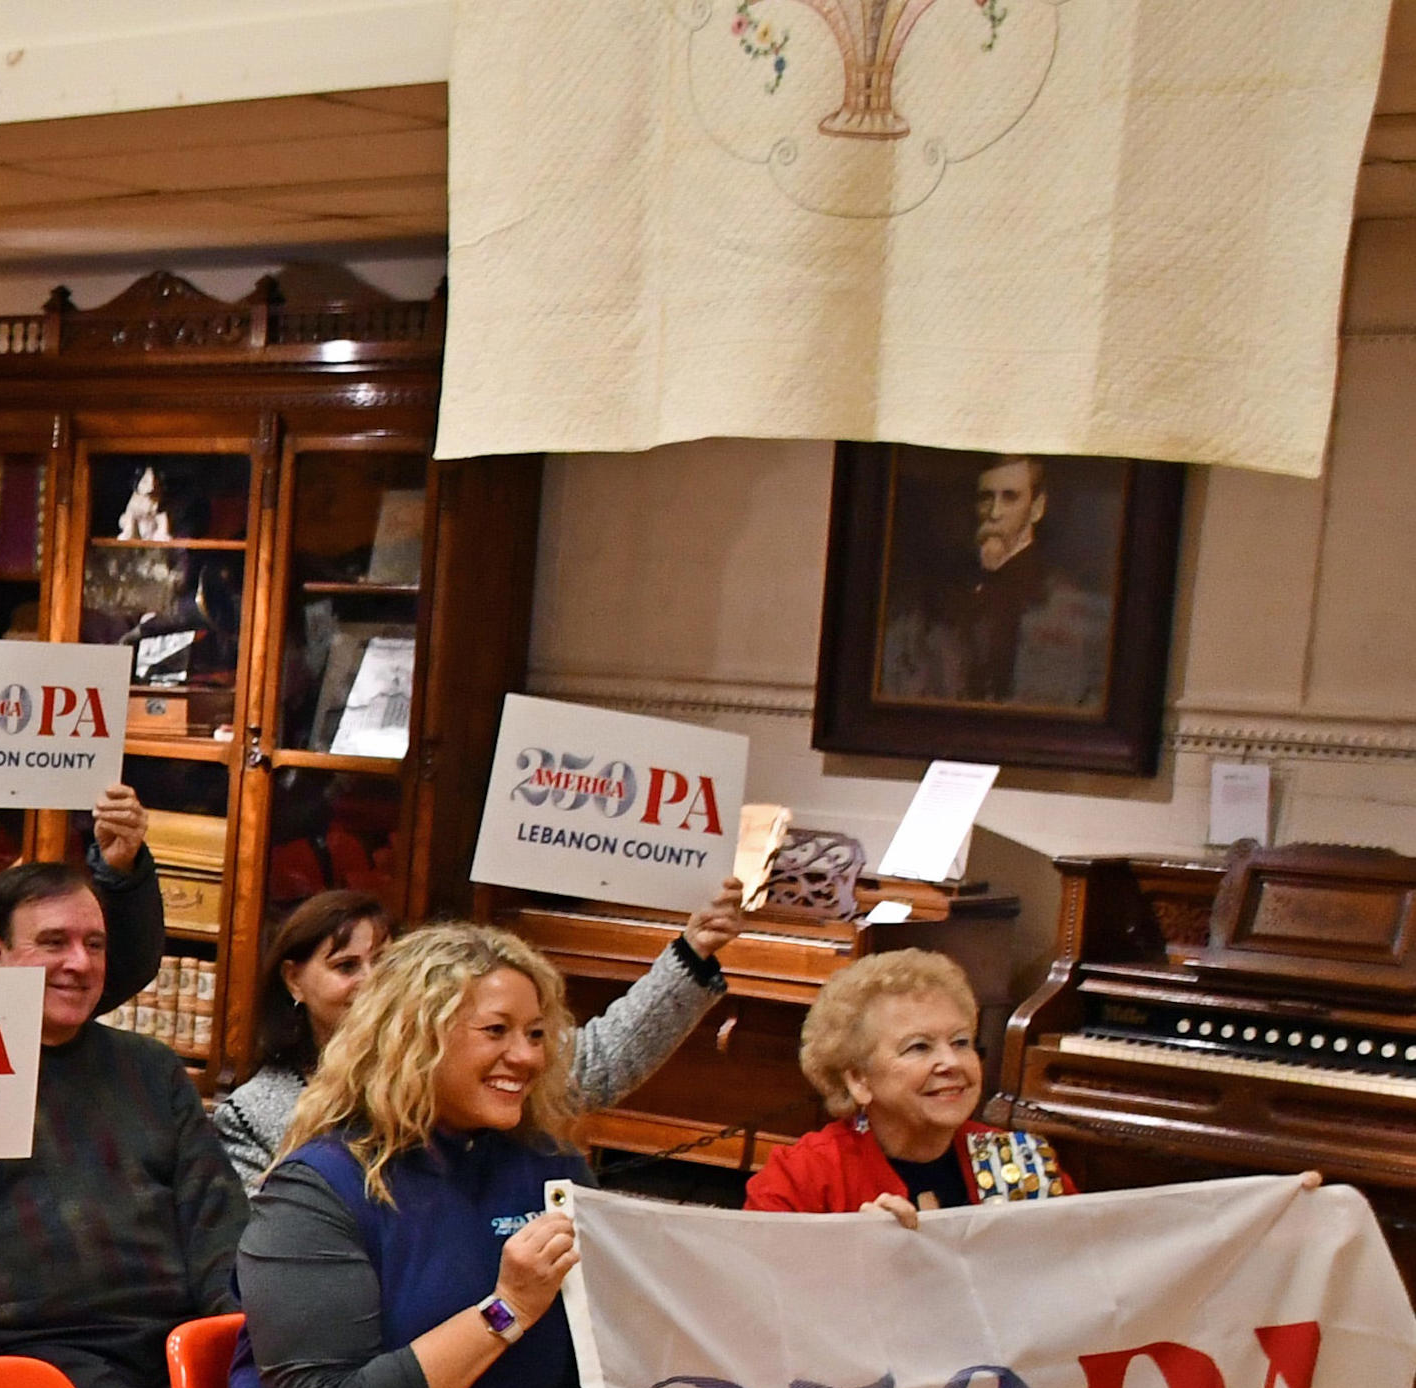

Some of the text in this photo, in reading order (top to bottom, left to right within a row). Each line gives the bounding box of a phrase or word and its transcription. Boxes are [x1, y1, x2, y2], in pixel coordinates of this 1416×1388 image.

[36, 685, 111, 738] PA
[26, 752, 95, 768] COUNTY
[510, 748, 724, 836] 250 PA
[527, 767, 627, 800] AMERICA
[518, 823, 707, 868] LEBANON COUNTY
